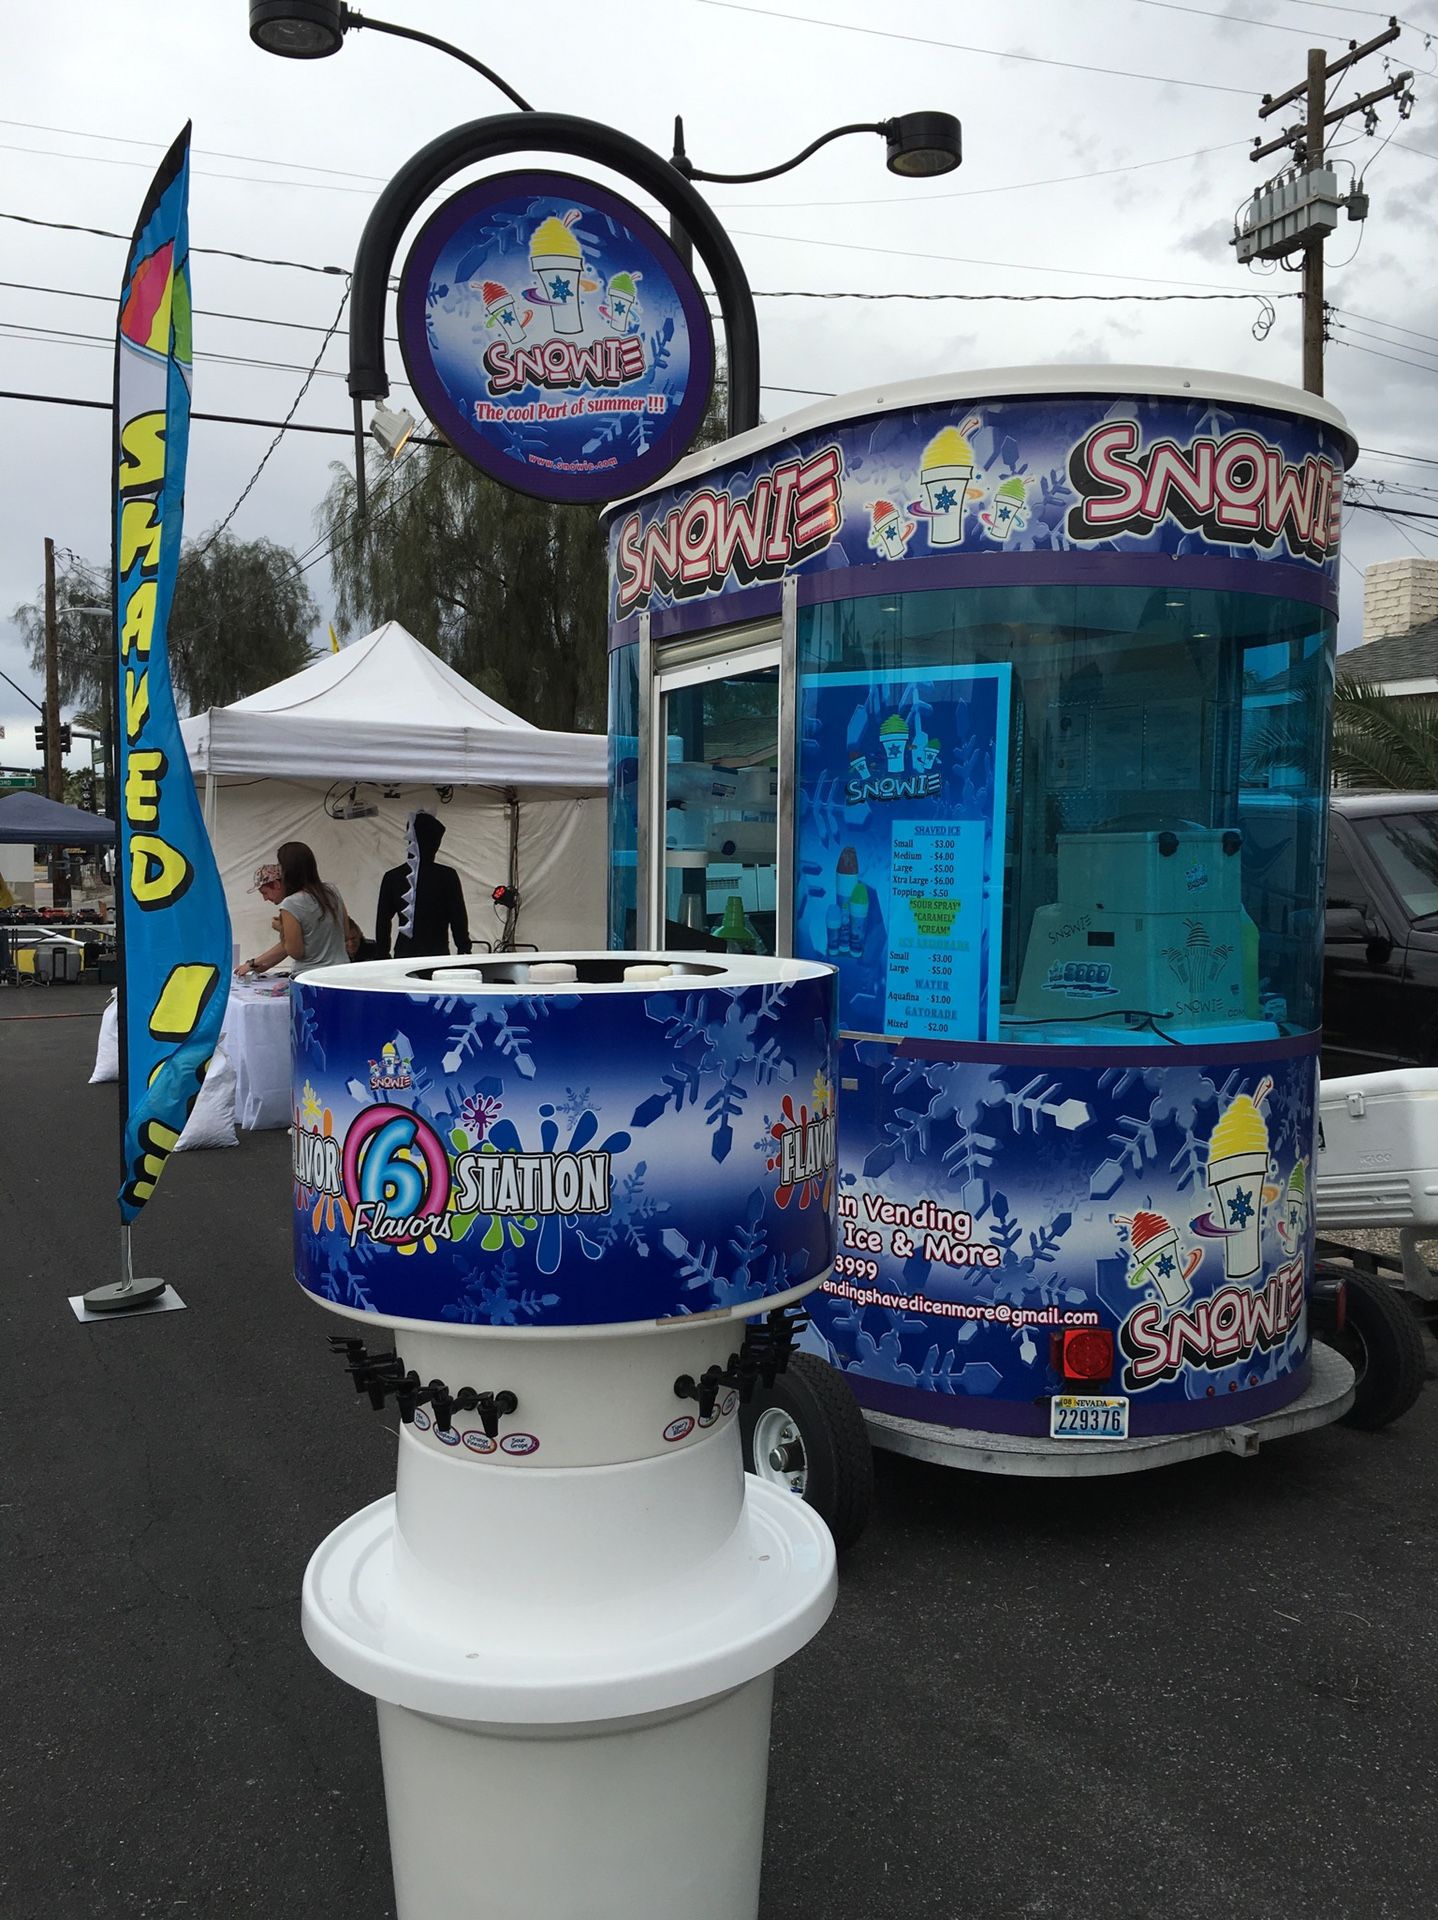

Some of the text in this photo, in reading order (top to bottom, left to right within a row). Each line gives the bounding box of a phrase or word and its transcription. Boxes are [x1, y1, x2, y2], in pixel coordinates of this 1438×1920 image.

[484, 337, 647, 395] SNOWIE
[476, 395, 665, 421] The cool Part of summer !!!
[528, 454, 618, 471] www.snowie.com
[1067, 420, 1342, 564] SNOWIE
[616, 444, 842, 622] SNOWIE
[846, 773, 941, 806] SNOWIE
[914, 825, 960, 836] SHAVED ICE
[894, 840, 913, 848] Small
[893, 852, 922, 860] Medium
[893, 864, 913, 873] Large
[892, 876, 908, 884] Xtra
[909, 876, 929, 886] Large
[892, 888, 925, 898] Toppings
[889, 951, 909, 960] Small
[889, 963, 909, 973] Large
[915, 980, 949, 990] WATER
[888, 991, 919, 1001] Aquafina
[905, 1006, 957, 1020] GATORADE
[1176, 999, 1223, 1016] SNOWIE
[887, 1019, 909, 1028] Mixed
[370, 1075, 412, 1090] SNOWIE
[360, 1114, 424, 1219] 6
[454, 1150, 611, 1215] STATION
[350, 1201, 452, 1249] Flavors
[863, 1193, 973, 1241] Vending
[844, 1221, 1001, 1268] Ice & More
[835, 1253, 879, 1281] 3999
[818, 1278, 1099, 1327] endingshavedicenmore@gmail.com
[1121, 1256, 1303, 1392] SNOWIE
[1075, 1399, 1108, 1407] NEVADA
[1058, 1409, 1121, 1432] 229376
[510, 1442, 529, 1450] Grape
